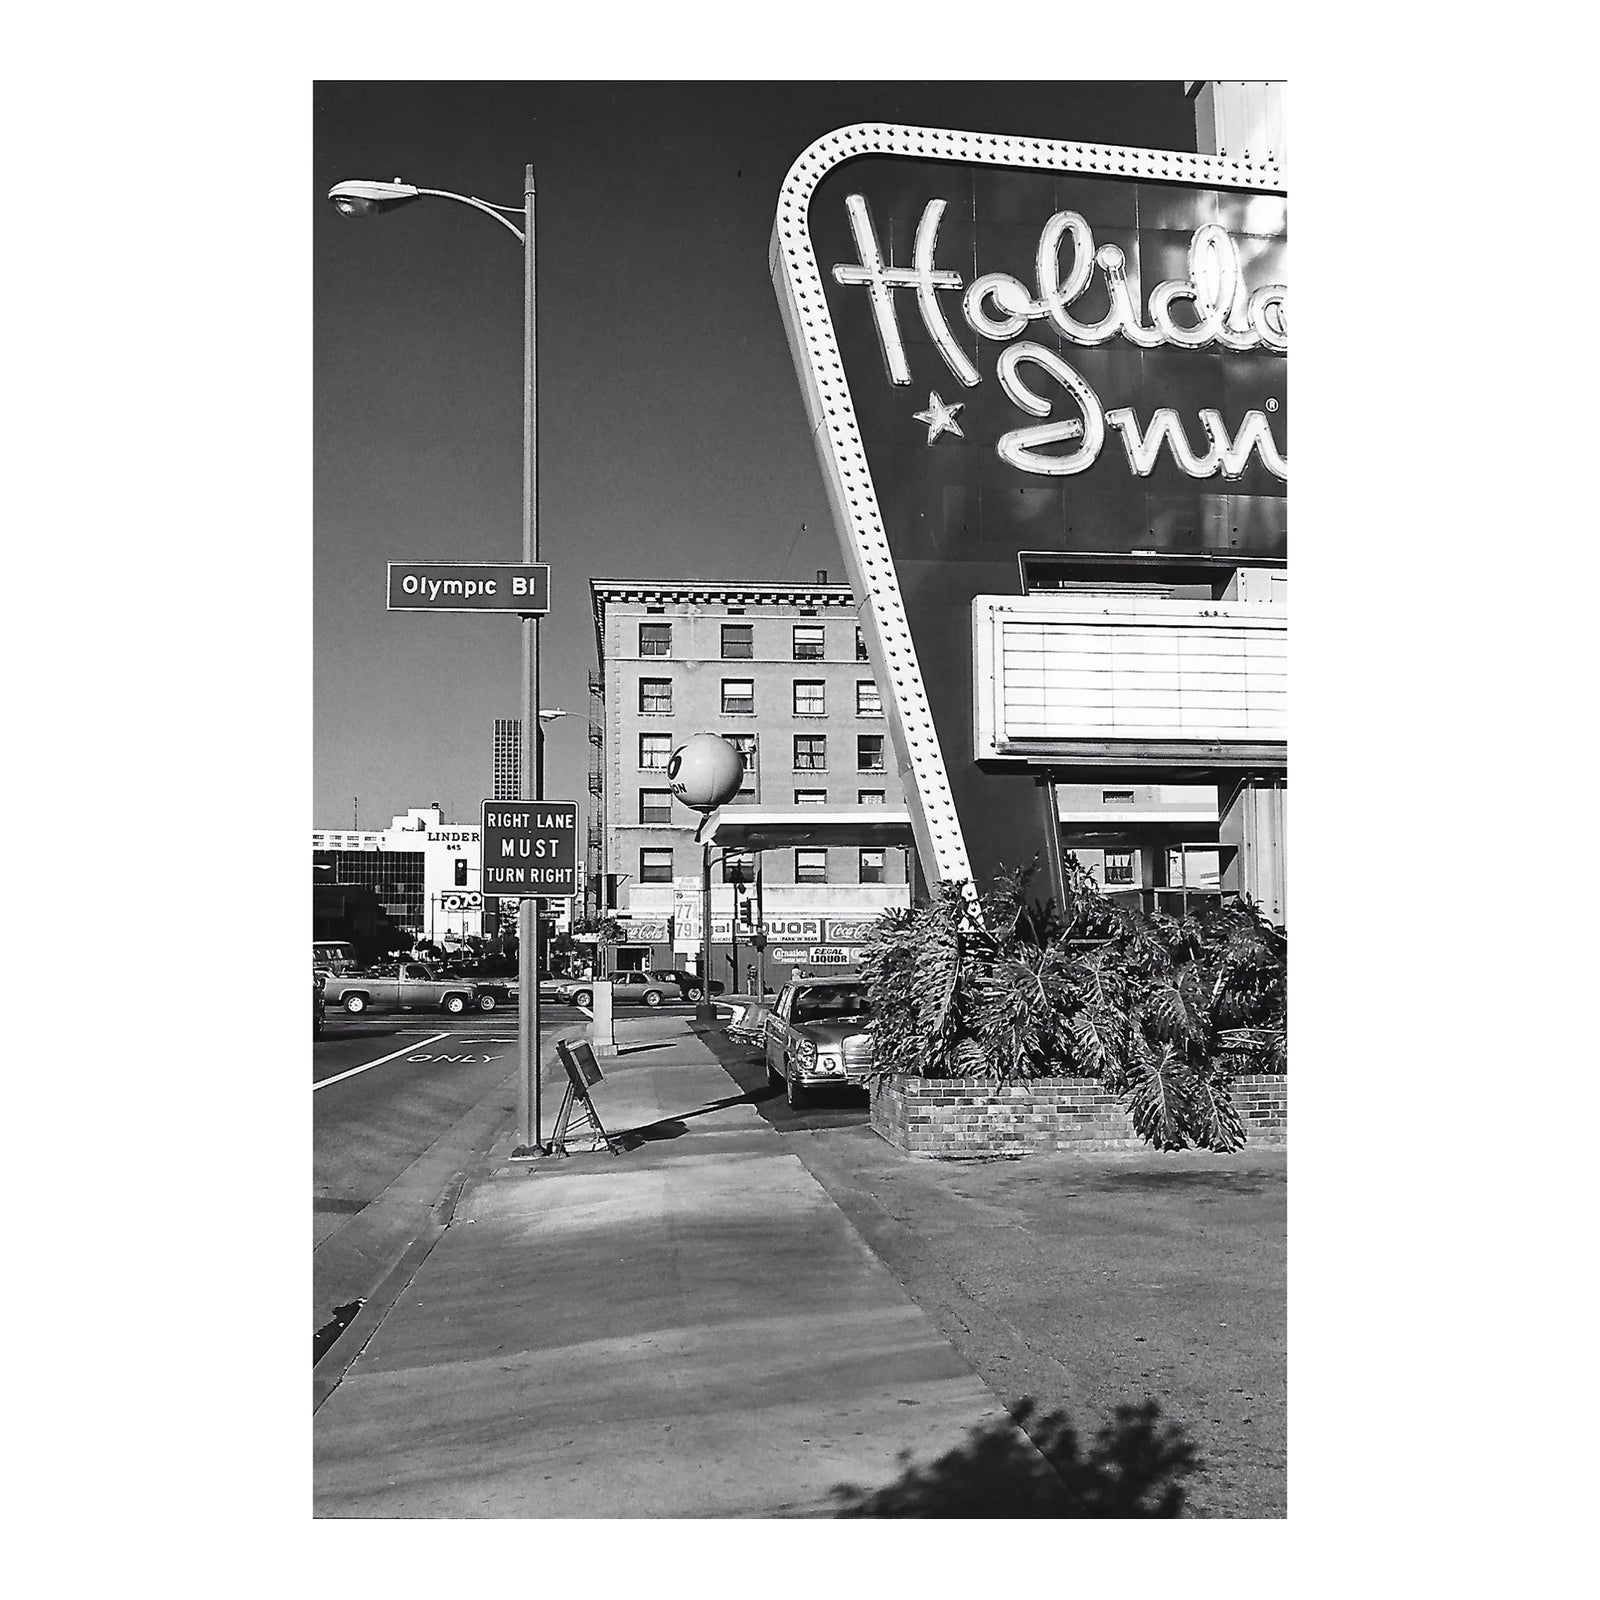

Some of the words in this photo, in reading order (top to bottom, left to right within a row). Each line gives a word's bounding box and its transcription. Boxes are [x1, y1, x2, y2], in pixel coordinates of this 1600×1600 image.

[998, 341, 1287, 482] Inn
[402, 575, 497, 601] Olympic
[512, 577, 535, 596] Bl
[487, 812, 530, 828] RIGHT
[537, 813, 574, 829] LANE
[427, 832, 481, 841] LINDER
[501, 838, 559, 858] MUST
[486, 867, 525, 882] TURN
[530, 868, 573, 883] RIGHT
[810, 955, 848, 963] LIQUOR
[407, 1054, 504, 1063] ONLY
